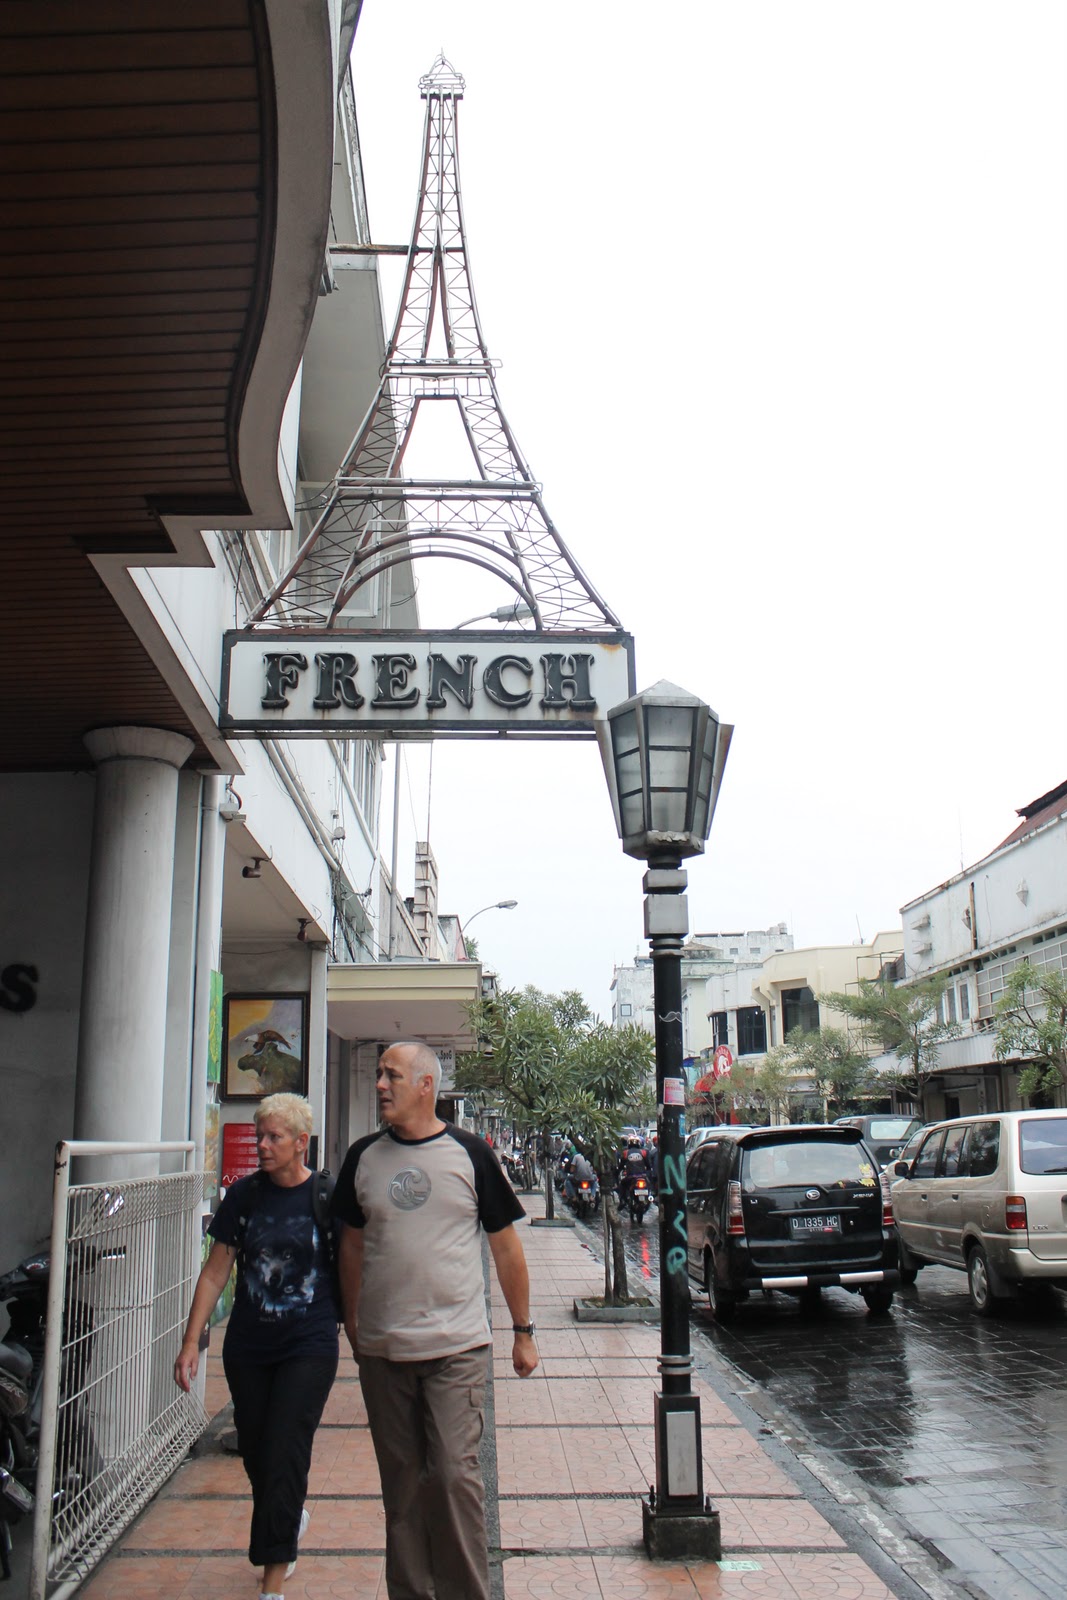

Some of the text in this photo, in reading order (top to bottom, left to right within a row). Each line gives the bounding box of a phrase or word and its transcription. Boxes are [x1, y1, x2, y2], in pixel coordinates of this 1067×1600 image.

[260, 652, 598, 709] FRENCH
[792, 1215, 838, 1228] D 1335 HC
